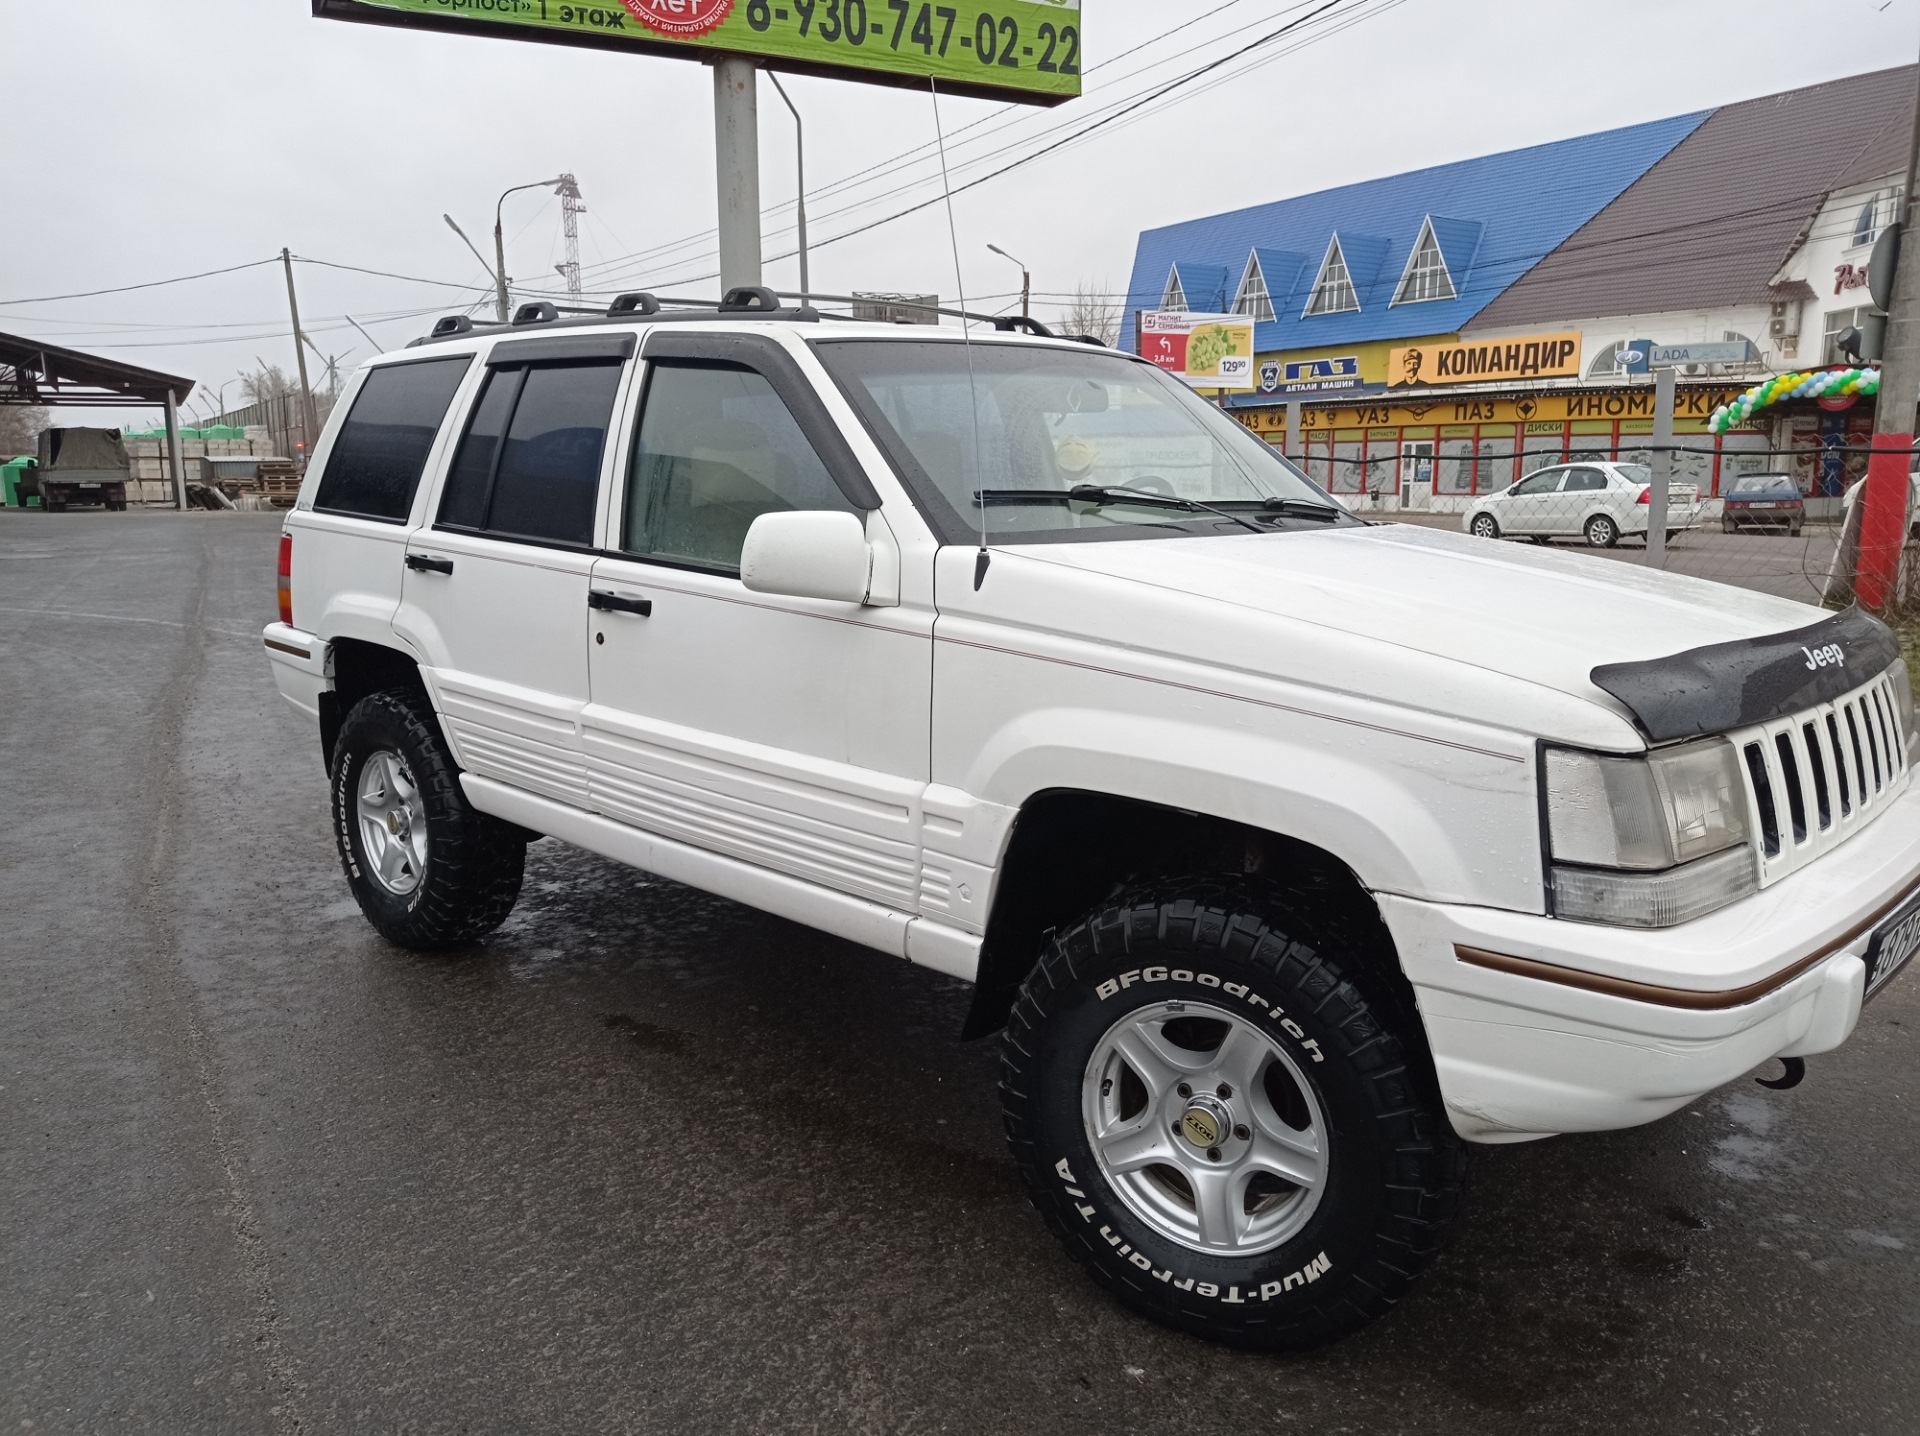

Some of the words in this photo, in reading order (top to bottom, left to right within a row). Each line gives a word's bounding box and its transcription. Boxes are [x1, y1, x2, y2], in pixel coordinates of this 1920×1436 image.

[538, 0, 548, 20] 1
[559, 5, 626, 30] этаж
[660, 21, 704, 33] ГАРАНТИЯ
[746, 0, 1079, 76] 8-930-747-02-22
[1158, 322, 1190, 330] СЕМЕЙНЫЙ
[1154, 354, 1165, 363] 2,8
[1437, 340, 1575, 376] КОМАНДИР
[1654, 349, 1690, 361] LADA
[1285, 356, 1358, 381] ГАЗ
[1285, 383, 1317, 393] ДЕТАЛИ
[1321, 380, 1354, 390] МАШИН
[1454, 402, 1495, 421] ПАЗ
[1566, 393, 1726, 417] ИНОМРКИ
[1299, 411, 1316, 428] АЗ
[1356, 407, 1390, 425] УАЗ
[1309, 432, 1328, 440] МАСЛА
[1368, 428, 1397, 438] ЗАПЧАСТИ
[1526, 422, 1562, 433] ДИСКИ
[1801, 643, 1844, 671] Jeep
[1095, 966, 1325, 1063] BFGoodrich
[1185, 1115, 1214, 1141] DOTZ
[1055, 1157, 1096, 1223] T/A
[1100, 1225, 1333, 1304] Mud-Terrain
